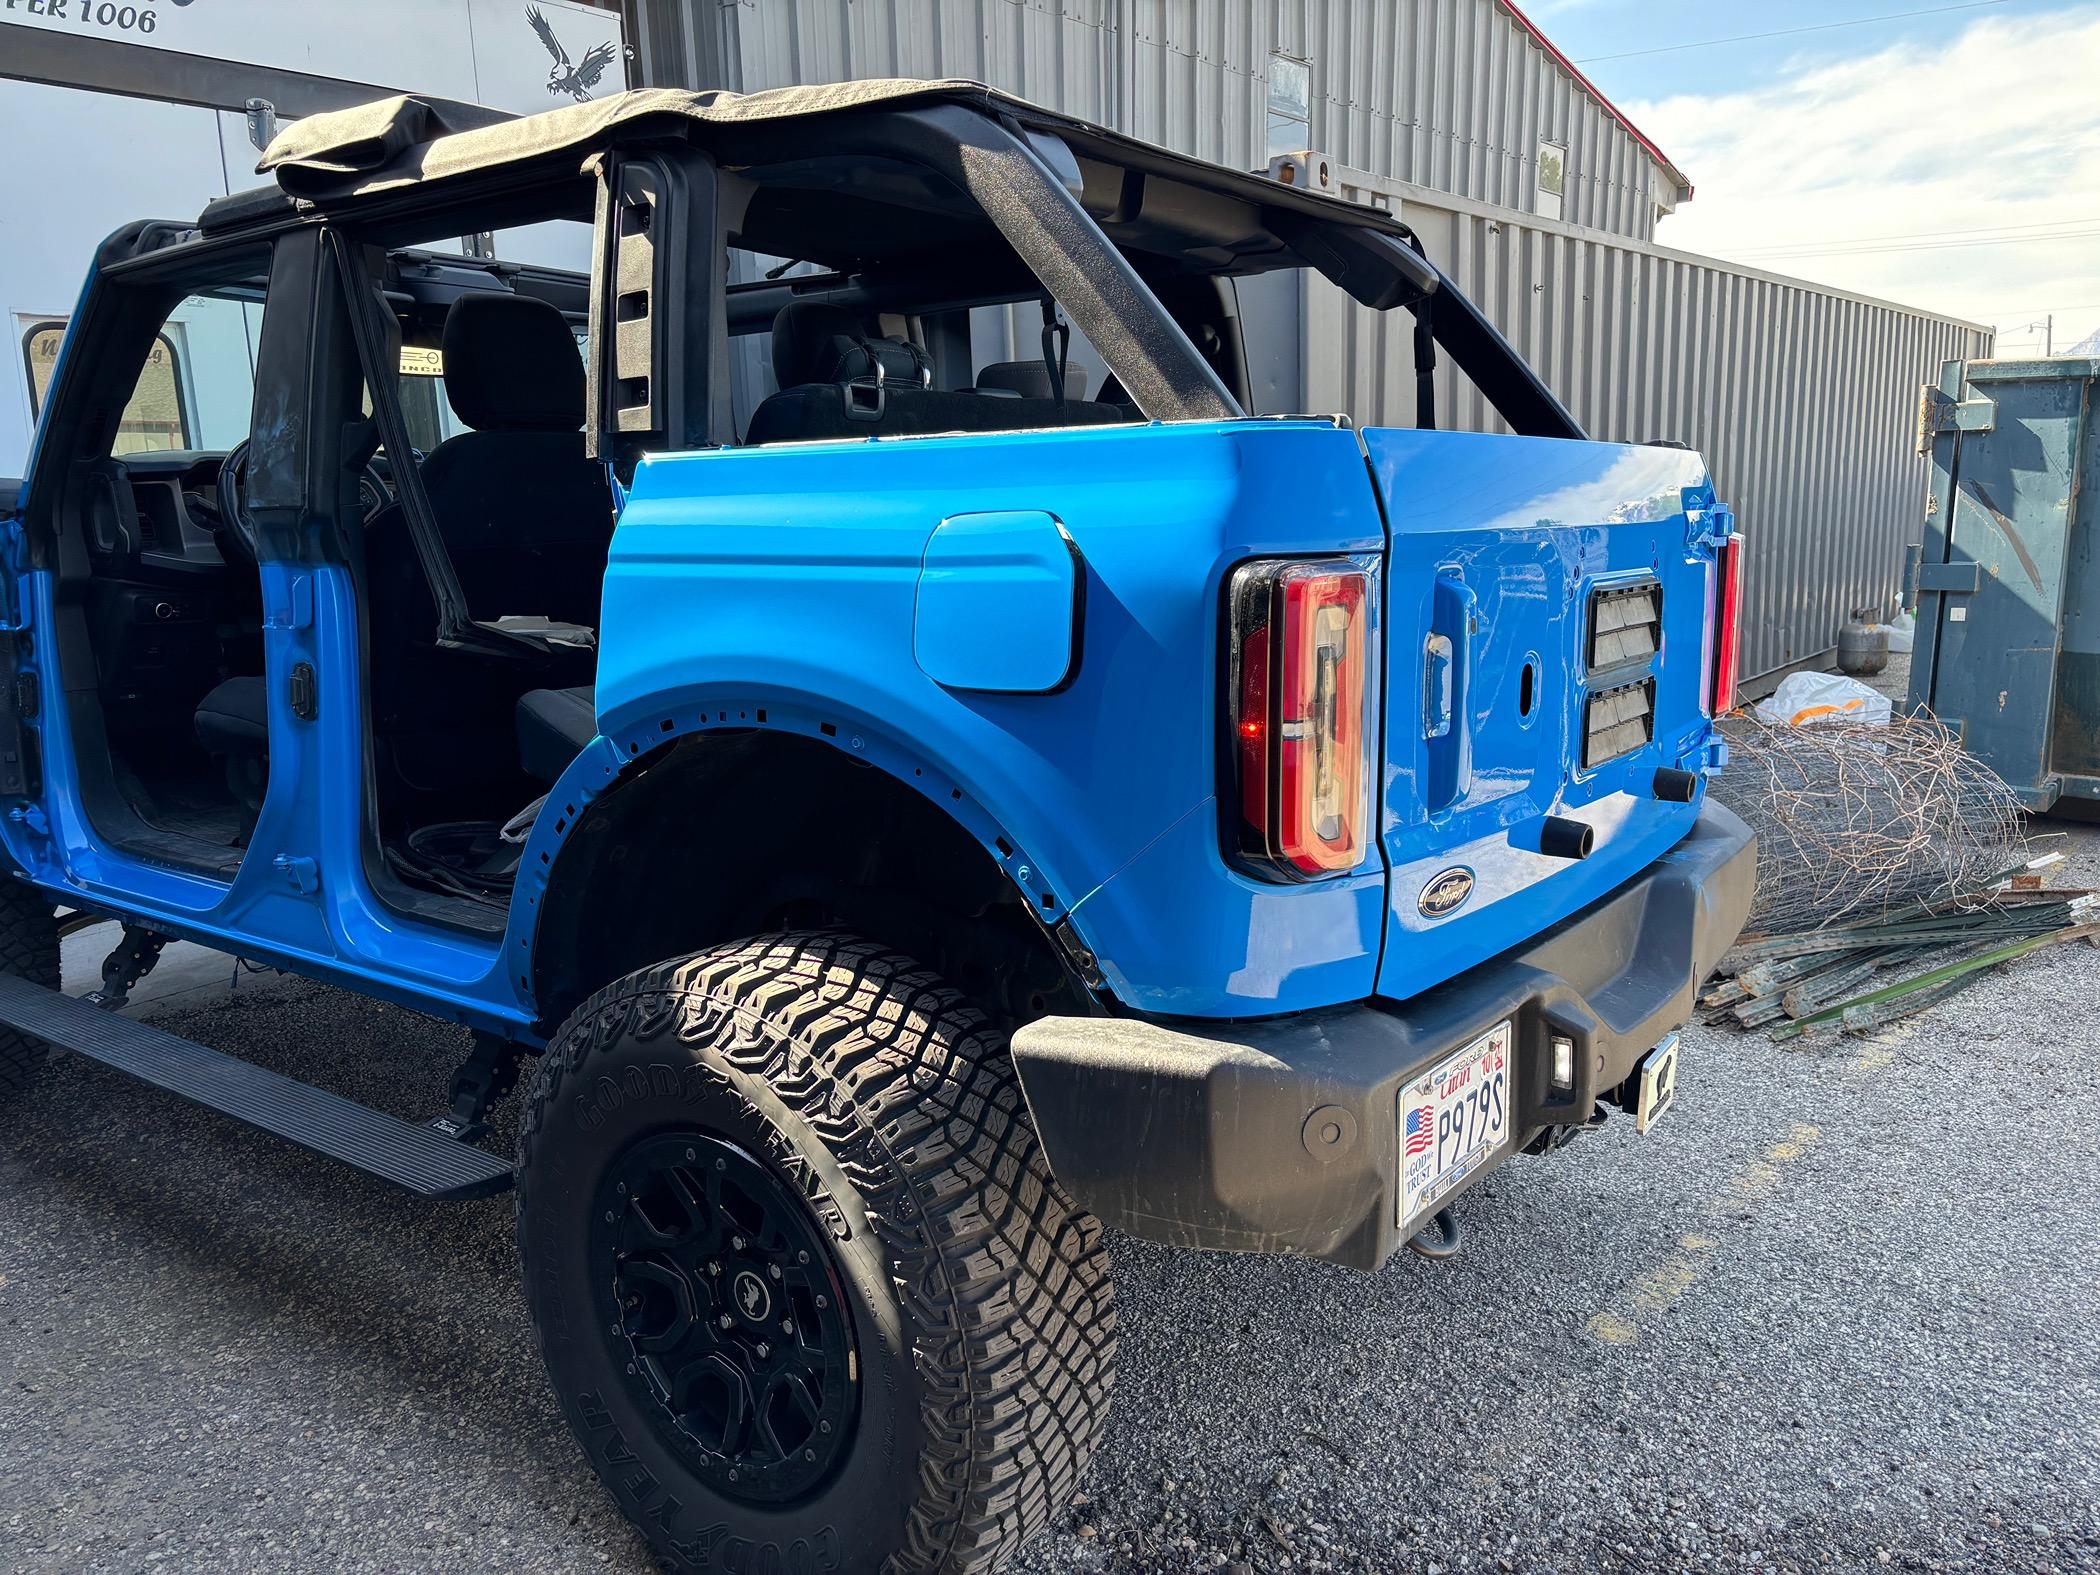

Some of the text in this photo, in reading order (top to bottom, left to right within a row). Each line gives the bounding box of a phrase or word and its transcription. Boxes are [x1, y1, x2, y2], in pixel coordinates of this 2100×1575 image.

[81, 0, 157, 33] 1006
[1434, 878, 1468, 910] Ford
[1406, 1163, 1432, 1195] TRUST
[1409, 1153, 1427, 1177] GOD
